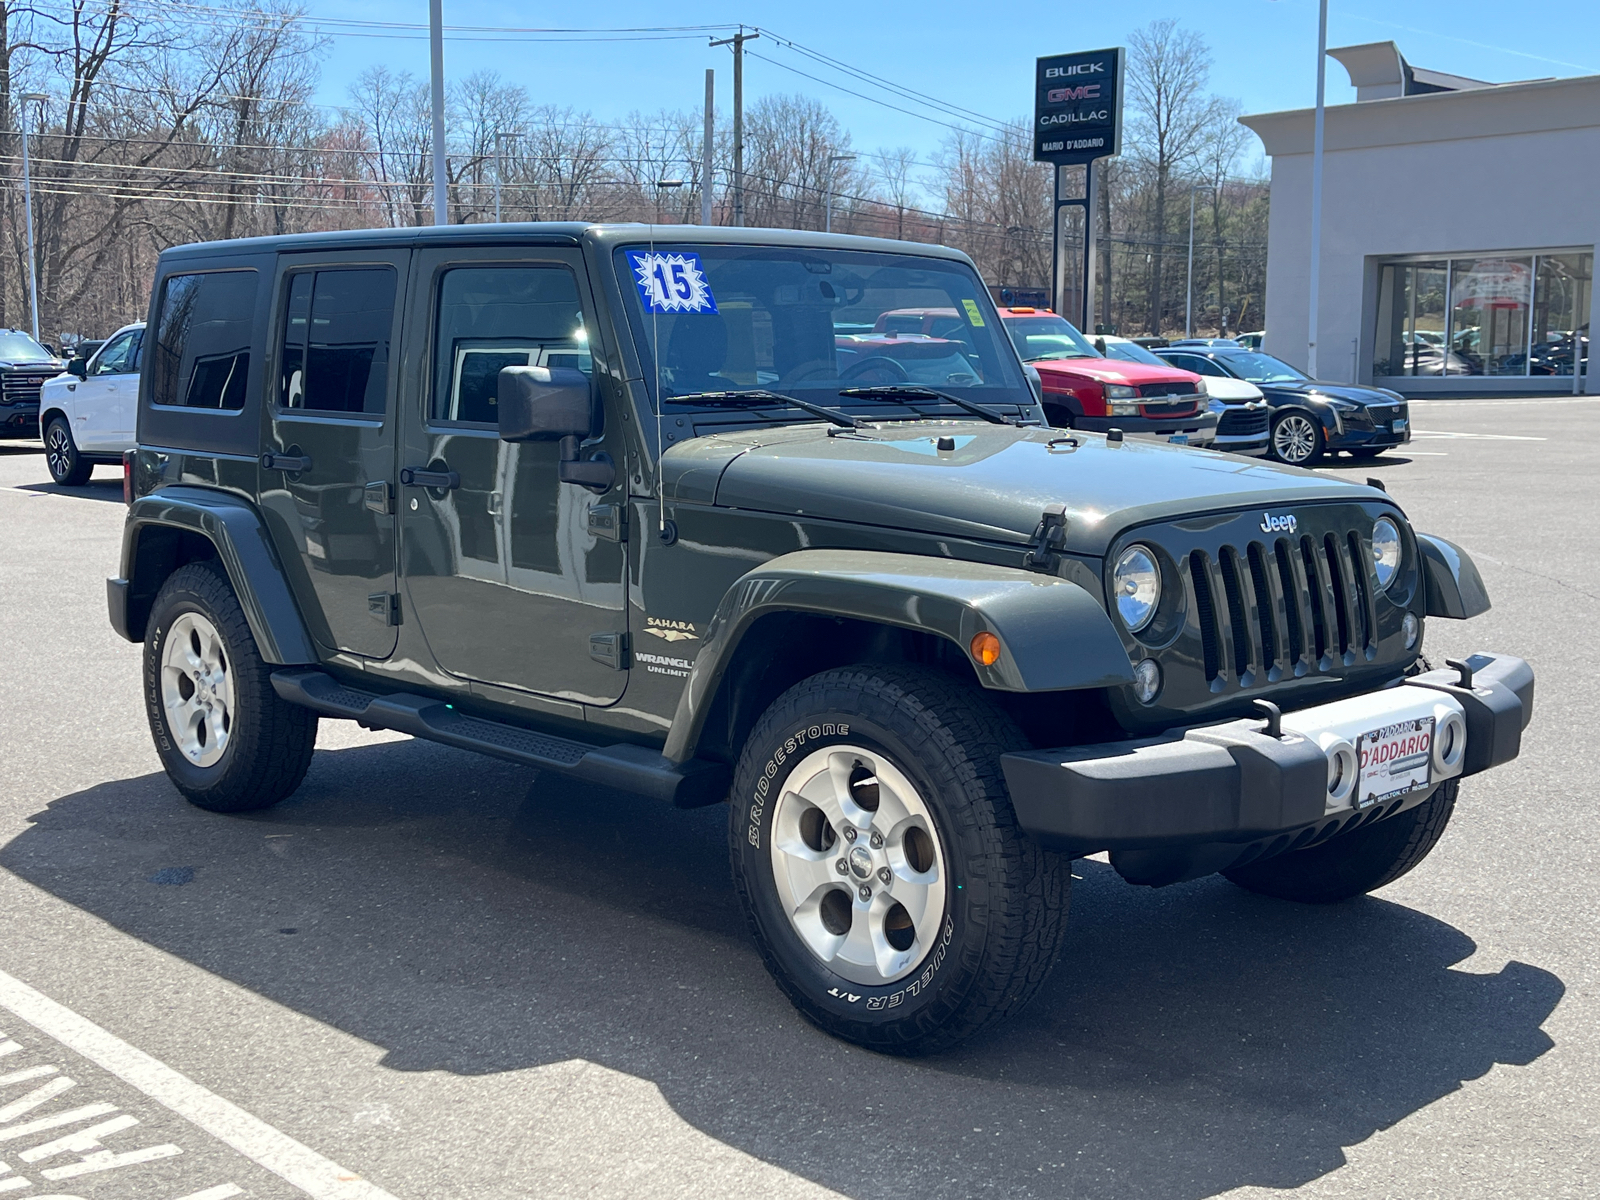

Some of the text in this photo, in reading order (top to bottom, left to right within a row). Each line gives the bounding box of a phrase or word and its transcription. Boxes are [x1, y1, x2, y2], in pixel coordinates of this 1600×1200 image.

[1045, 62, 1105, 78] BUICK
[1047, 84, 1101, 103] GMC
[1040, 110, 1108, 125] CADILLAC
[1042, 138, 1104, 152] MARIO D'ADDARIO
[653, 263, 693, 301] 15
[1260, 512, 1298, 534] Jeep
[647, 617, 696, 632] SAHARA
[647, 665, 690, 678] UNLIMIT
[1379, 721, 1416, 740] D'ADDARIO
[1360, 732, 1430, 770] D'ADDARIO
[748, 723, 850, 849] BRIDGESTONE
[1402, 787, 1410, 795] CT
[827, 913, 955, 1010] DUELER A/T
